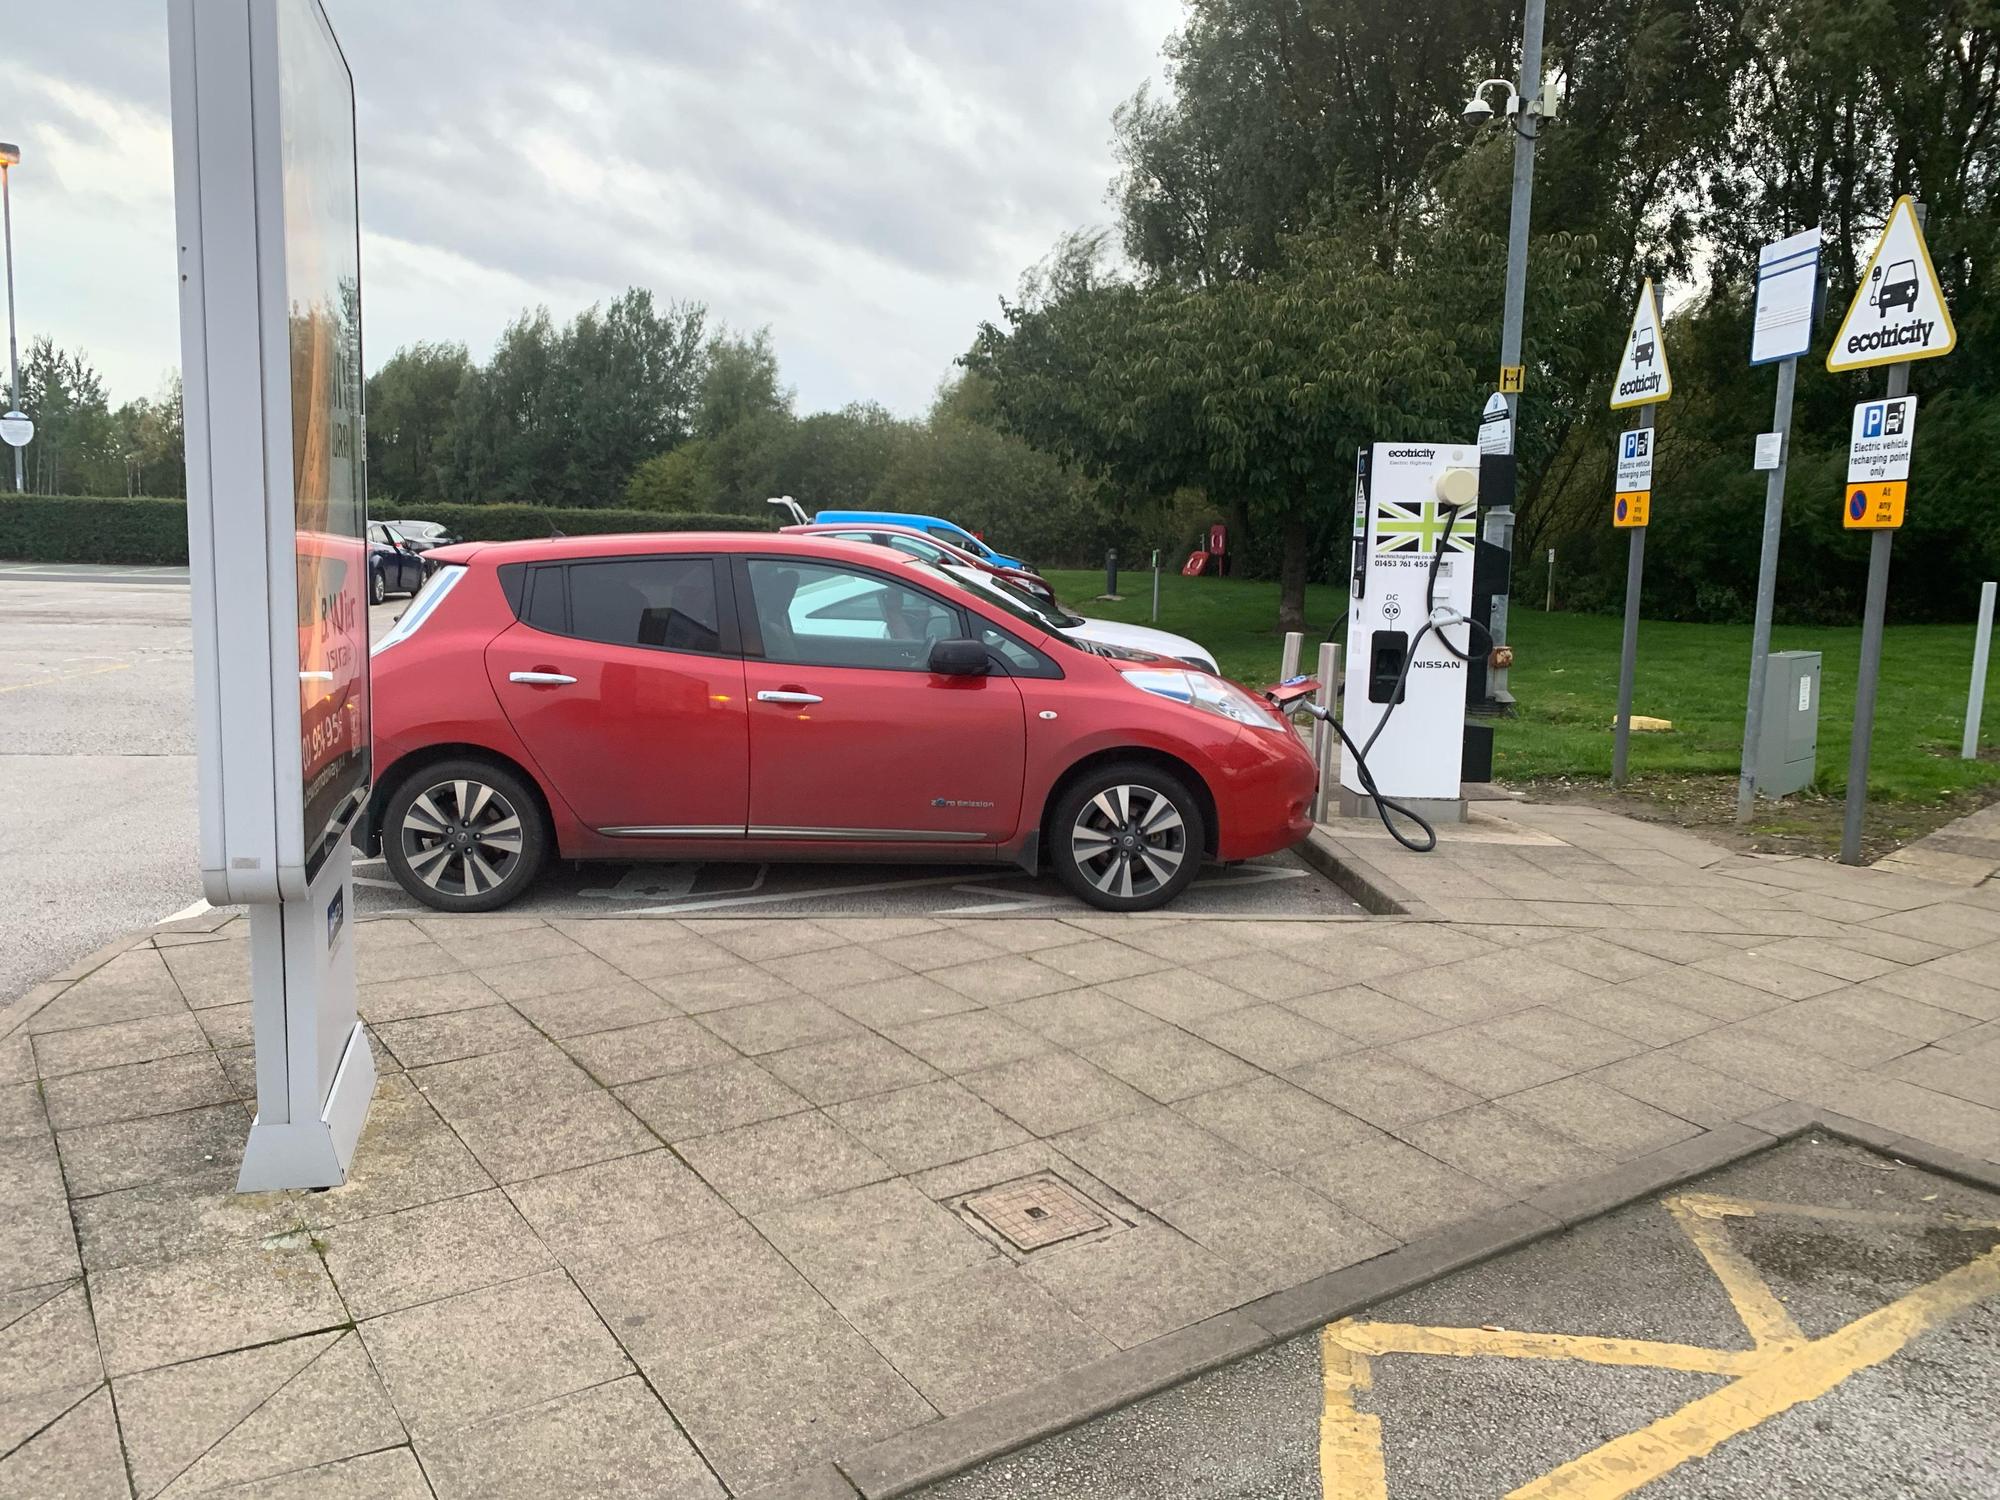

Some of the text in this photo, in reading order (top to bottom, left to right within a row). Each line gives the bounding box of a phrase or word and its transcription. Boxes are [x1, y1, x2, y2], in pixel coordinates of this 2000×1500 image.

[1847, 318, 1935, 354] ecotricity
[1502, 368, 1522, 390] H
[1619, 371, 1662, 396] ecotricity
[1854, 438, 1909, 453] Electric vehicle
[1388, 448, 1436, 460] ecotricity
[1850, 451, 1909, 466] recharging point
[1869, 465, 1886, 477] only
[1881, 486, 1891, 497] At
[1878, 501, 1892, 511] any
[1876, 512, 1892, 523] time
[1413, 560, 1429, 568] 455
[1385, 593, 1399, 601] DC
[1413, 661, 1461, 669] NISSAN
